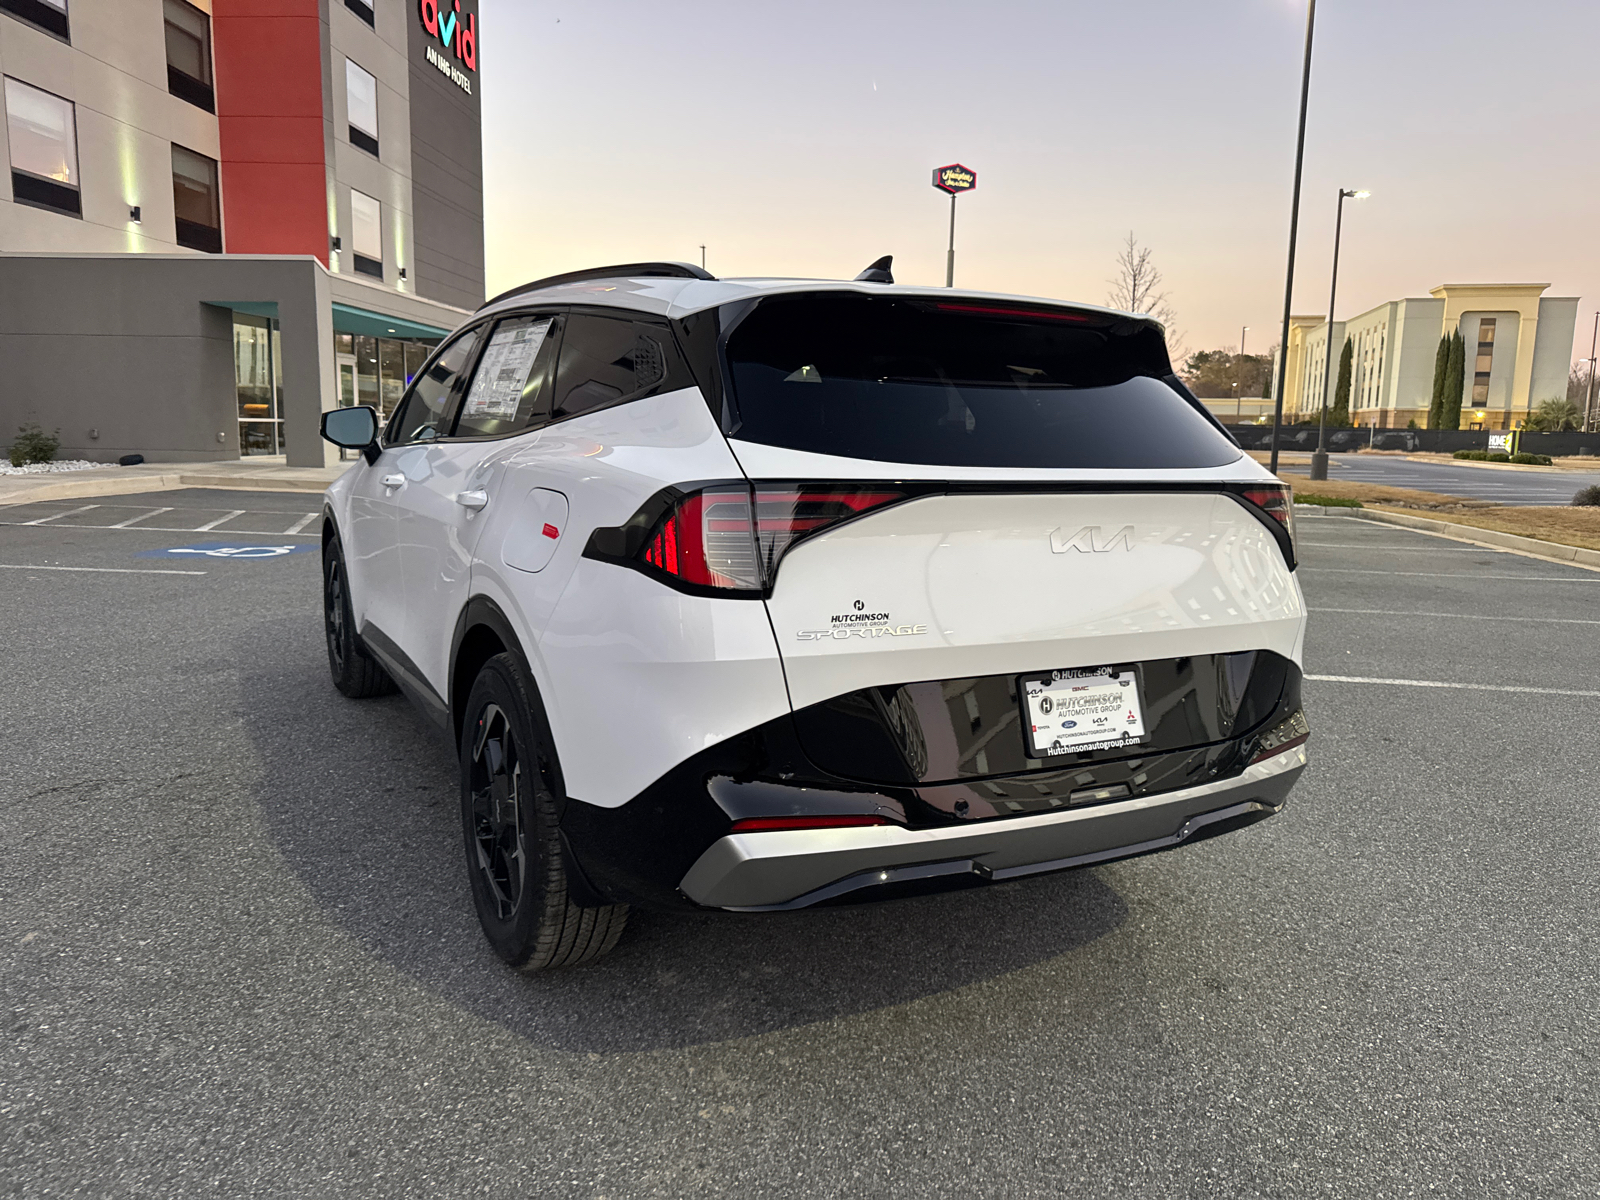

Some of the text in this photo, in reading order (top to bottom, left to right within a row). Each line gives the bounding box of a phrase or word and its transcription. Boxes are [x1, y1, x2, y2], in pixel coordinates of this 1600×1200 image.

[421, 0, 476, 71] avid
[426, 45, 472, 95] AN IHG HOTEL
[1049, 525, 1135, 554] KIA
[831, 613, 889, 622] HUTCHINSON
[797, 623, 928, 641] SPORTAGE
[1056, 692, 1123, 710] HUTCHINSON
[1058, 704, 1122, 717] AUTOMOTIVE GROUP
[1047, 737, 1140, 756] Hutchinsonautogroup.com
